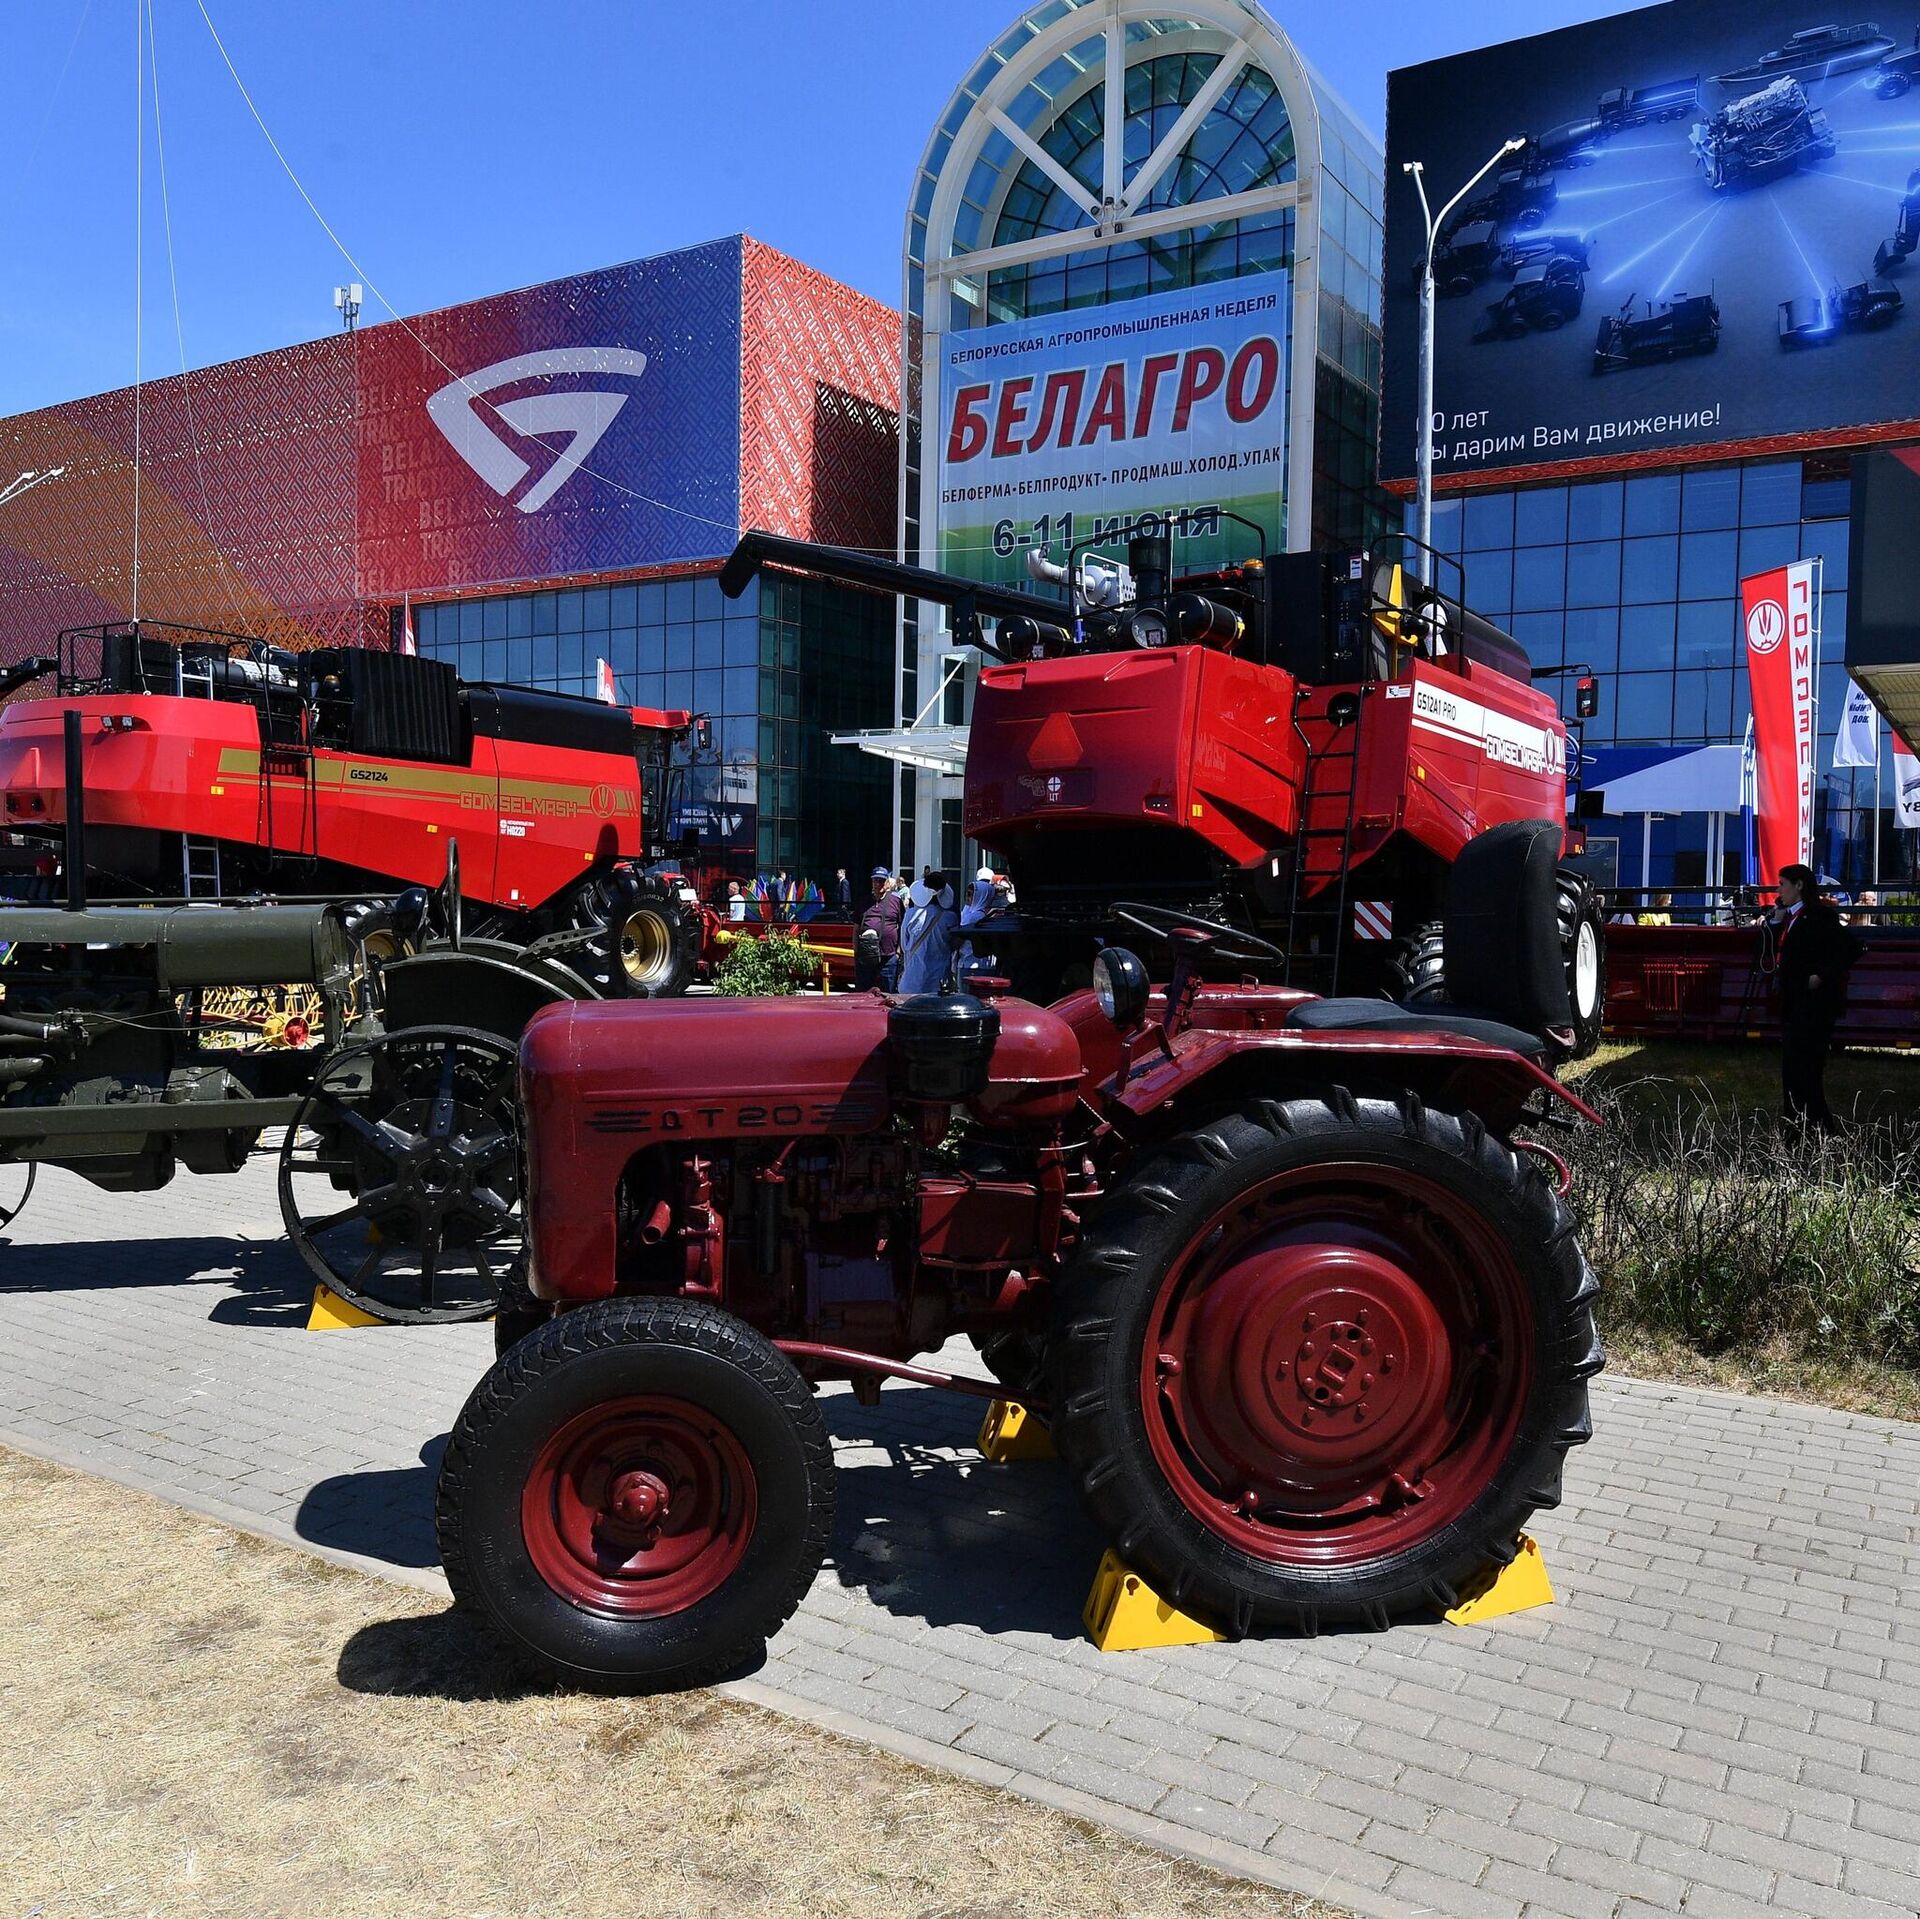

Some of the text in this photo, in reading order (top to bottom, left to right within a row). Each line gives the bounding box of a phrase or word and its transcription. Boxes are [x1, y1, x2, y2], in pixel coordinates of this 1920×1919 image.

[951, 294, 1277, 365] БЕЛОРУССКАЯ АГРОПРОМЫШЛЕННАЯ НЕДЕЛЯ
[945, 336, 1281, 464] БЕЛАГРО
[1451, 411, 1489, 430] лет
[1415, 403, 1721, 462] ы дарим Вам движение!
[992, 504, 1221, 559] 6-11 июня
[1416, 692, 1441, 715] GS12A1
[1442, 701, 1457, 721] PRO
[1486, 733, 1543, 774] GOMSELMASH
[350, 768, 389, 782] GS2124
[460, 791, 577, 818] GOMSELMASH
